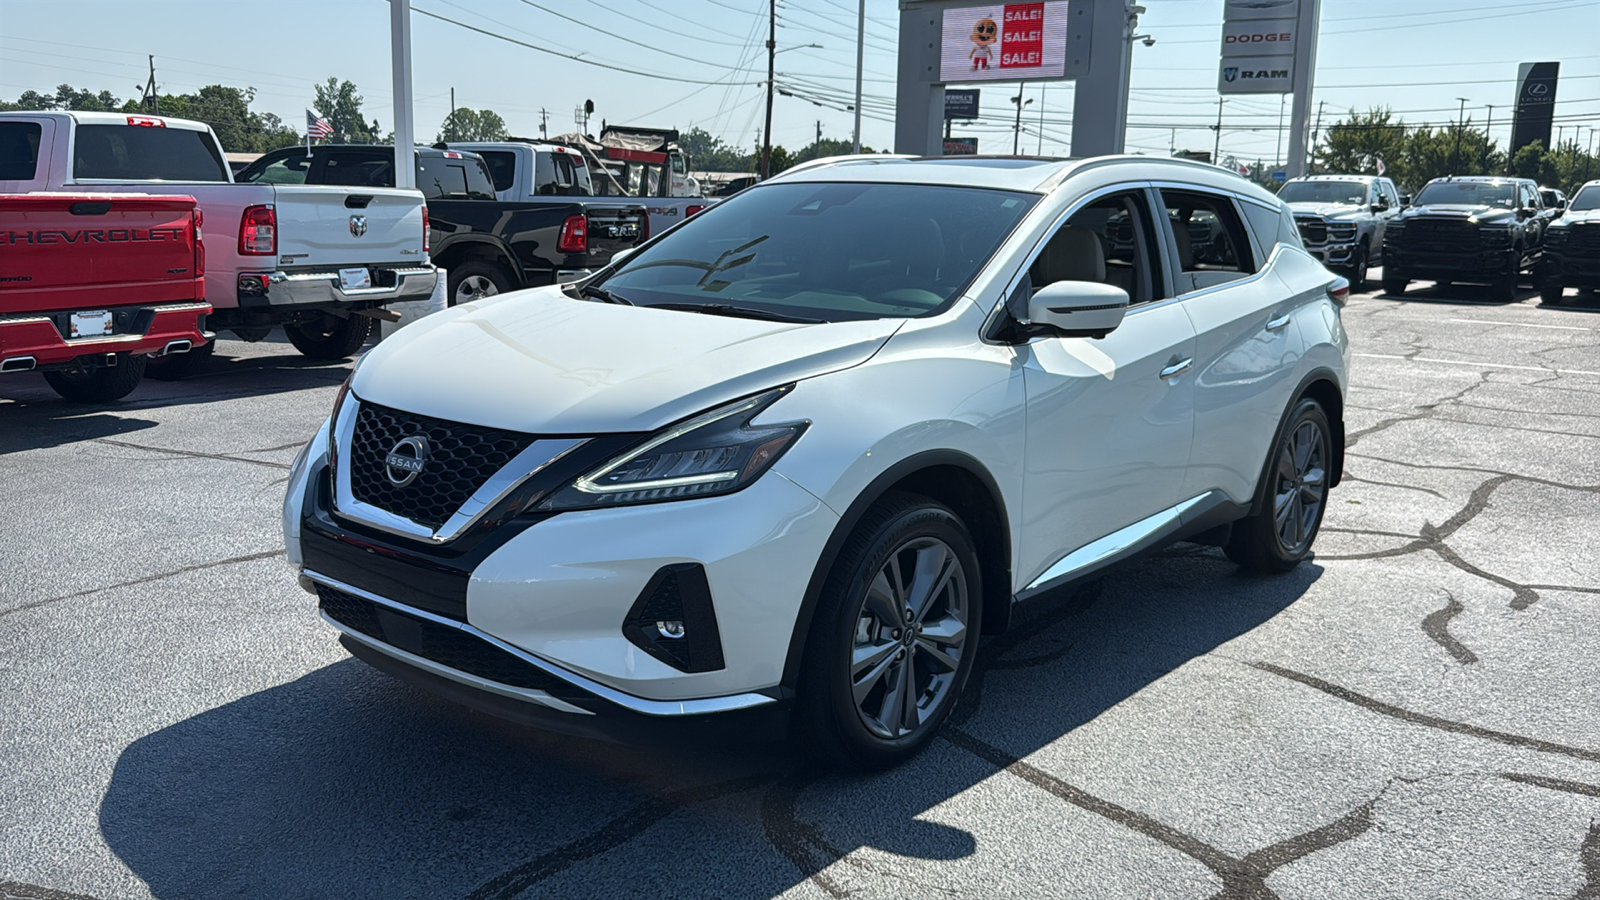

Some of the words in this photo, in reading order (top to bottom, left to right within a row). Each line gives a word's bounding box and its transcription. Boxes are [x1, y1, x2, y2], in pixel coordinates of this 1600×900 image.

[1005, 10, 1042, 21] SALE!
[1003, 31, 1041, 42] SALE!
[1225, 33, 1291, 43] DODGE
[1002, 52, 1040, 64] SALE!
[1241, 70, 1288, 79] RAM
[387, 456, 422, 470] ISSAN
